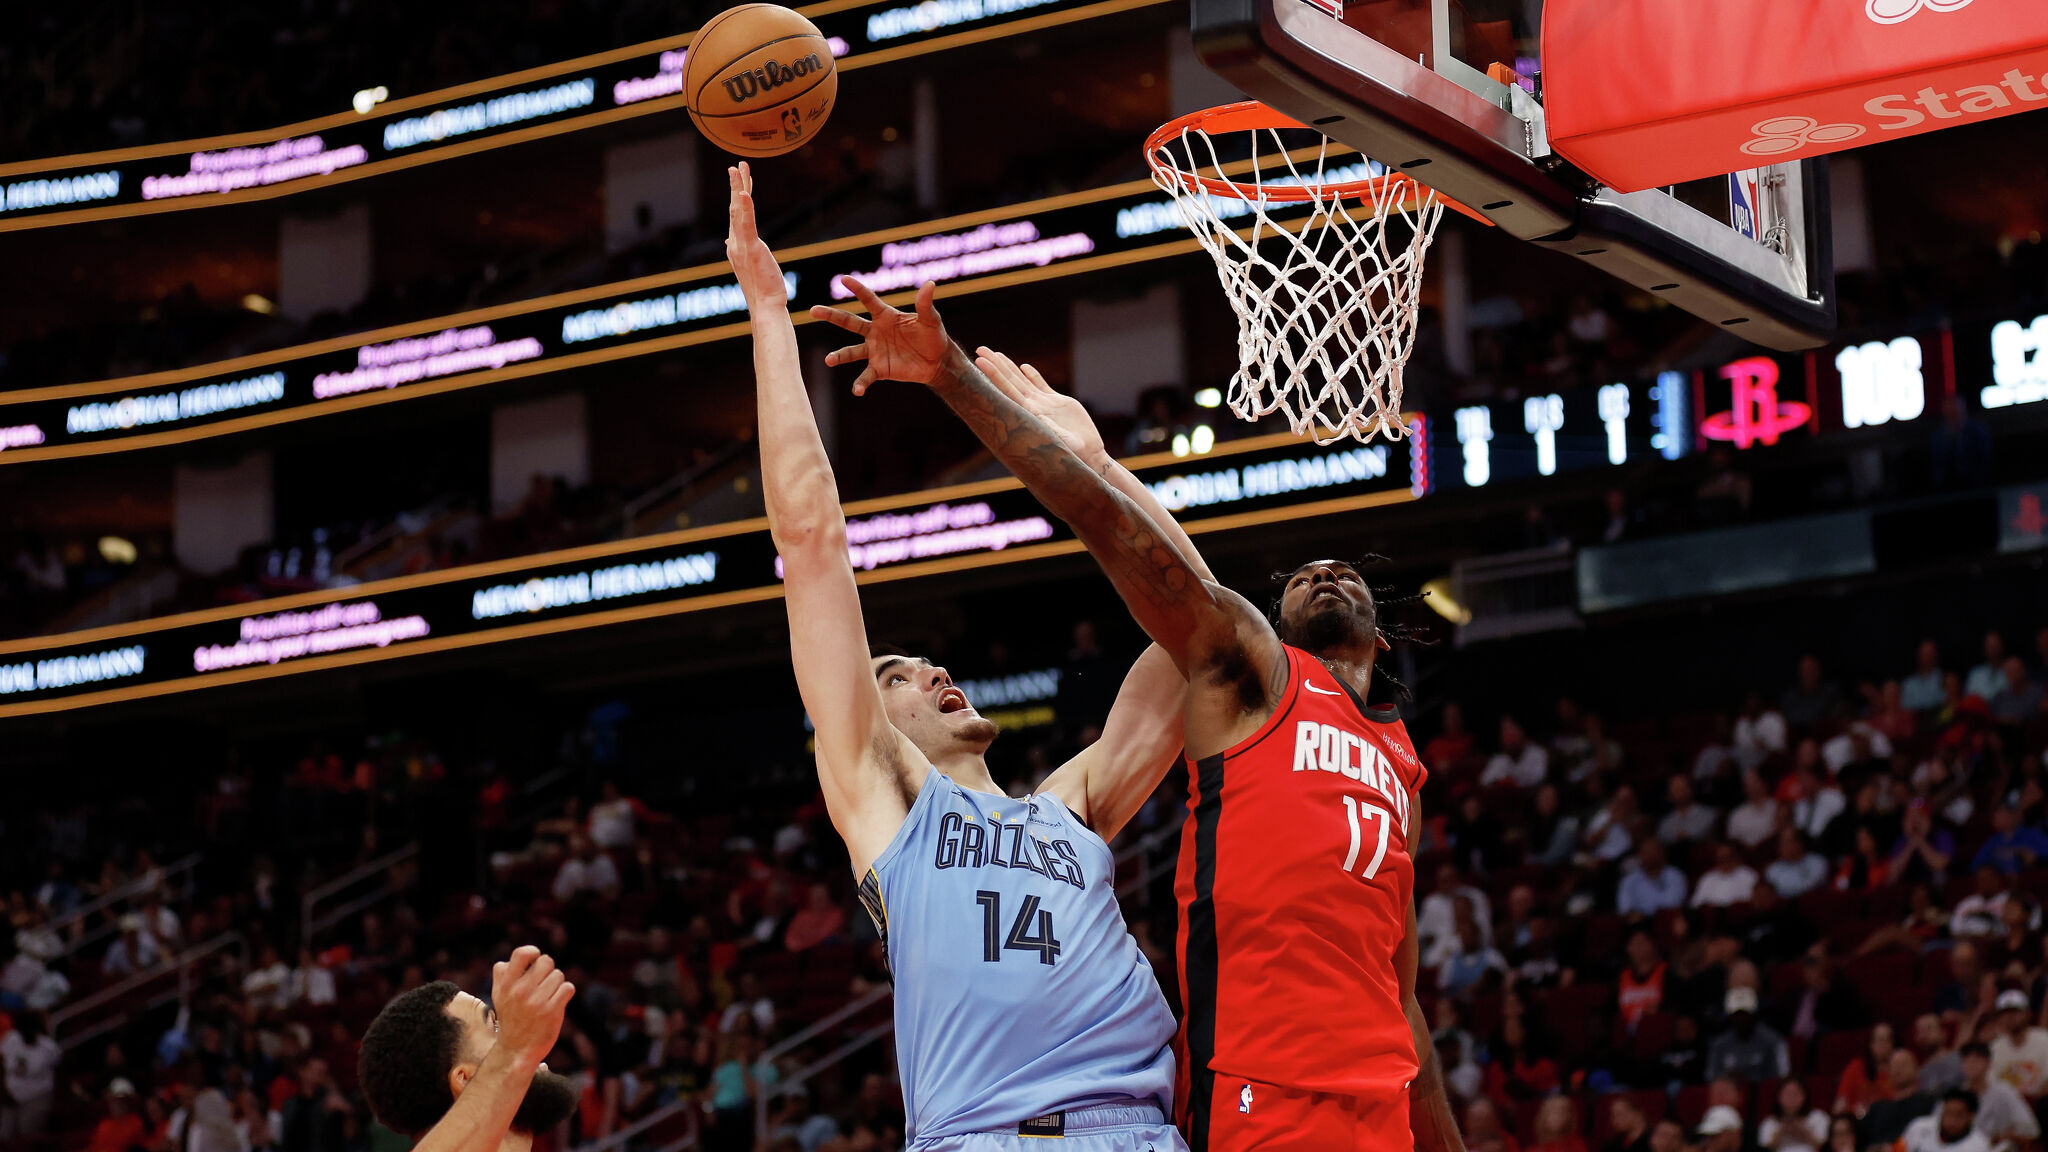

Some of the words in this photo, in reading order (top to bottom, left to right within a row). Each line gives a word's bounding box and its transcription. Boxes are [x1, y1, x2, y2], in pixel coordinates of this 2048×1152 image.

[721, 53, 823, 103] Wilson
[1863, 68, 2048, 130] Stat
[384, 102, 486, 150] MEMORIAL
[487, 78, 594, 126] HERMANN
[7, 171, 120, 211] HERMANN
[562, 294, 676, 344] MEMORIAL
[677, 271, 798, 322] HERMN
[67, 392, 179, 434] MEMORIAL
[179, 371, 285, 418] HERMANN
[1243, 445, 1388, 498] HERMANN
[472, 571, 592, 620] MEMORIAL
[592, 551, 717, 600] HERMANN
[37, 645, 145, 688] HERMANN
[1293, 721, 1410, 838] ROCKETS
[1343, 795, 1390, 880] 17
[976, 890, 1061, 966] 14
